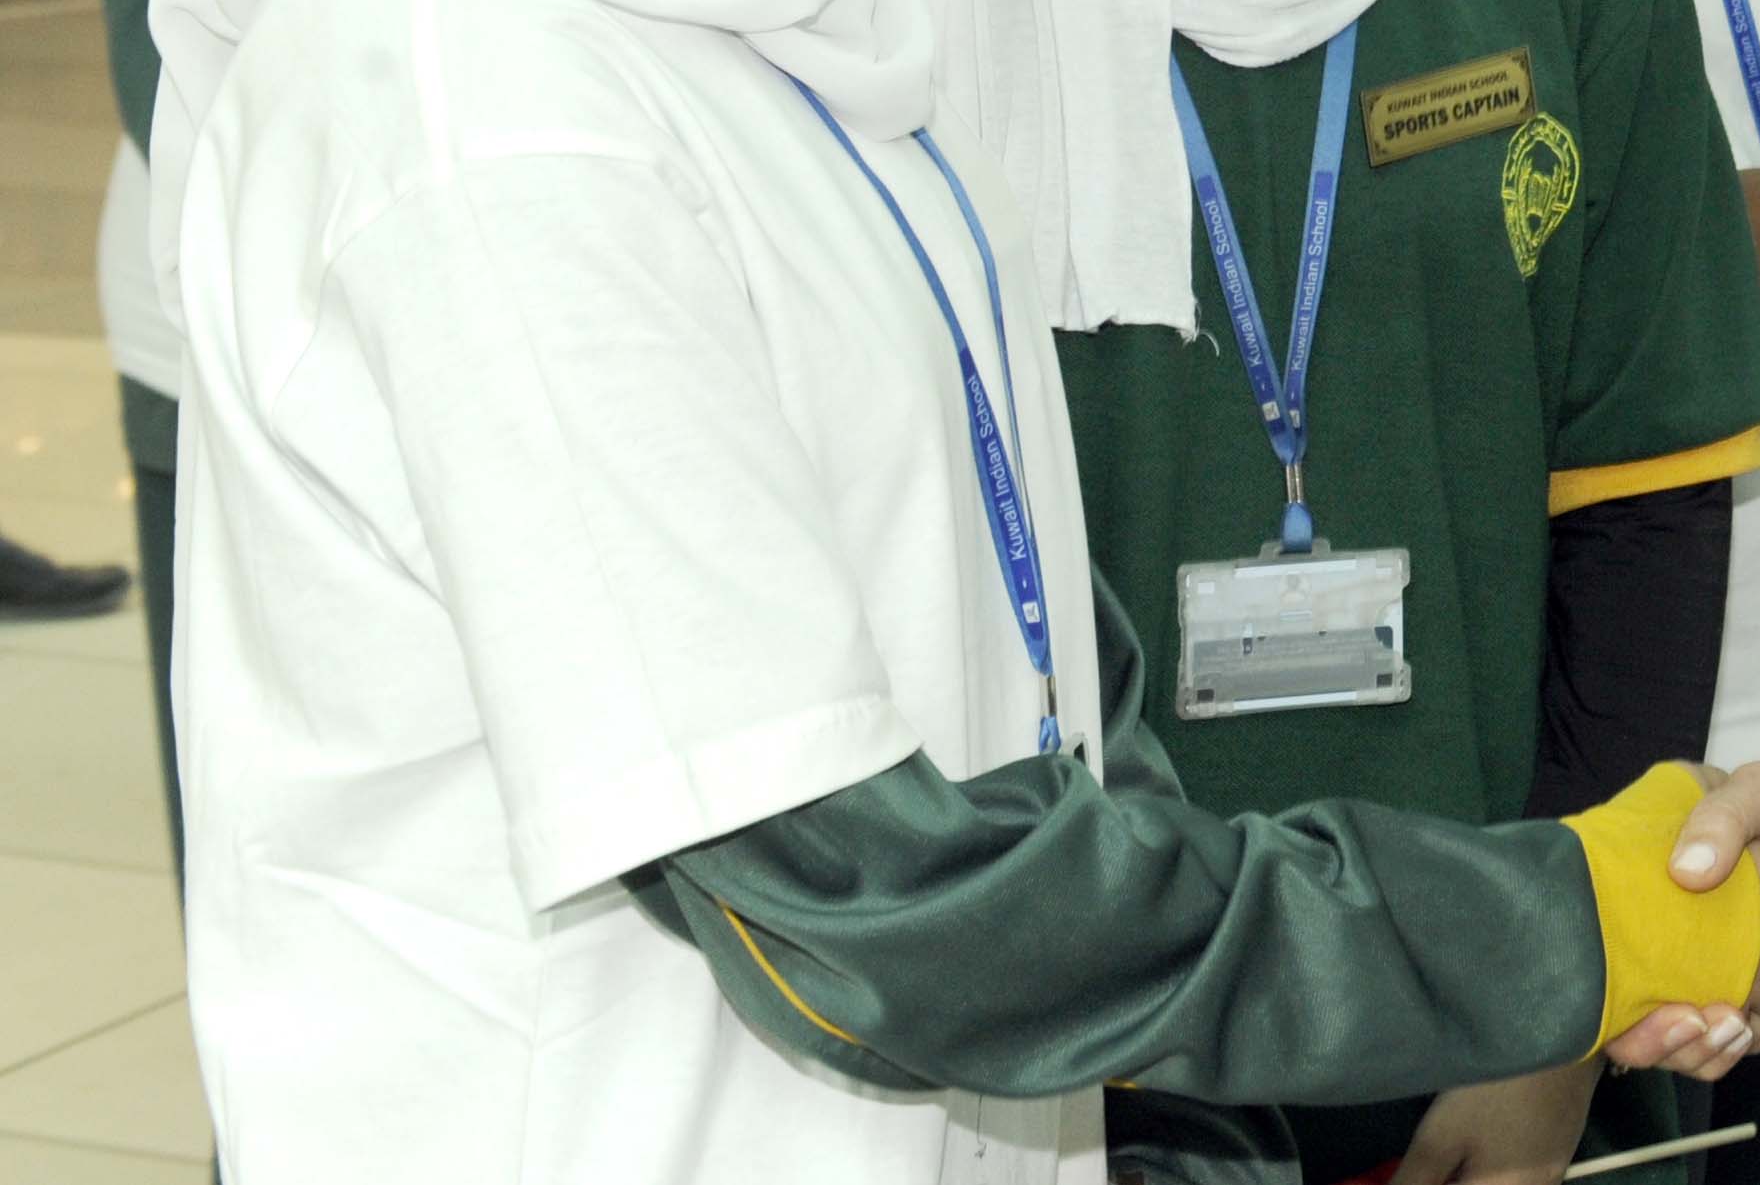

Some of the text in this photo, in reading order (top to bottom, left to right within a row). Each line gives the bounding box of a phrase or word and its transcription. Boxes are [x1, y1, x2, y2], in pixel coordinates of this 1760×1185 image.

[1384, 86, 1521, 140] SPORTS CAPTAIN
[1387, 70, 1508, 113] KUWAIT INDIAN SCHOOL
[1205, 200, 1263, 367] Kuwait Indian School
[1291, 200, 1329, 371] Kuwait Indian School
[968, 374, 1027, 561] Kuwait Indian School
